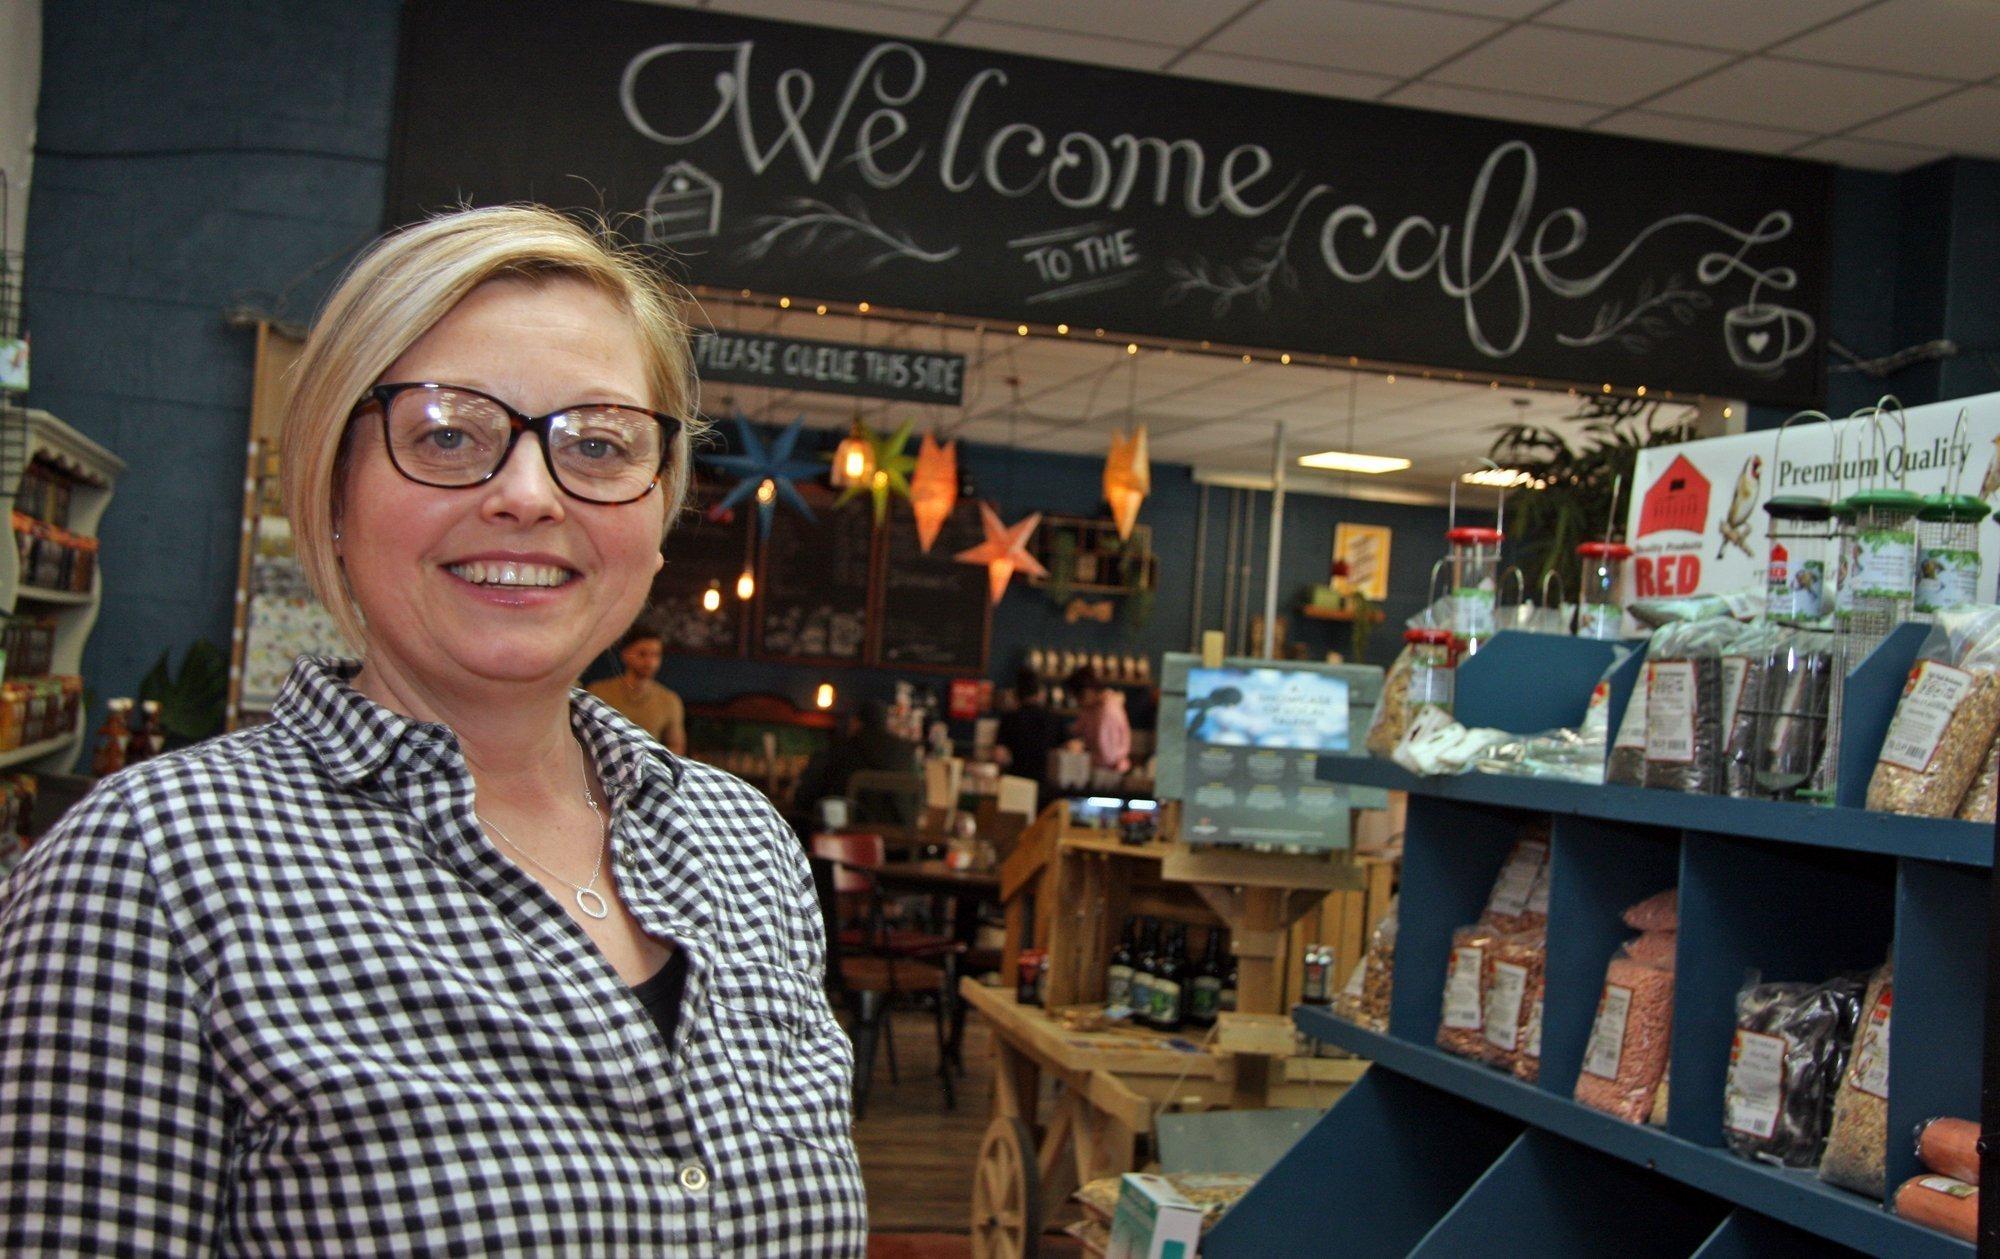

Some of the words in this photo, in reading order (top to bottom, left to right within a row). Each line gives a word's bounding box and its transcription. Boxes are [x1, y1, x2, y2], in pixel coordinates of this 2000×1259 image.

[619, 40, 1303, 218] Welcome
[1024, 247, 1072, 283] TO
[1074, 228, 1140, 270] THE
[1320, 140, 1625, 358] cafe
[697, 334, 778, 375] PLEASE
[783, 344, 860, 384] QUEUE
[864, 350, 910, 388] THIS
[912, 355, 963, 396] SIDE
[1779, 457, 1879, 488] Premium
[1885, 437, 1972, 481] Quality
[1635, 554, 1701, 598] RED
